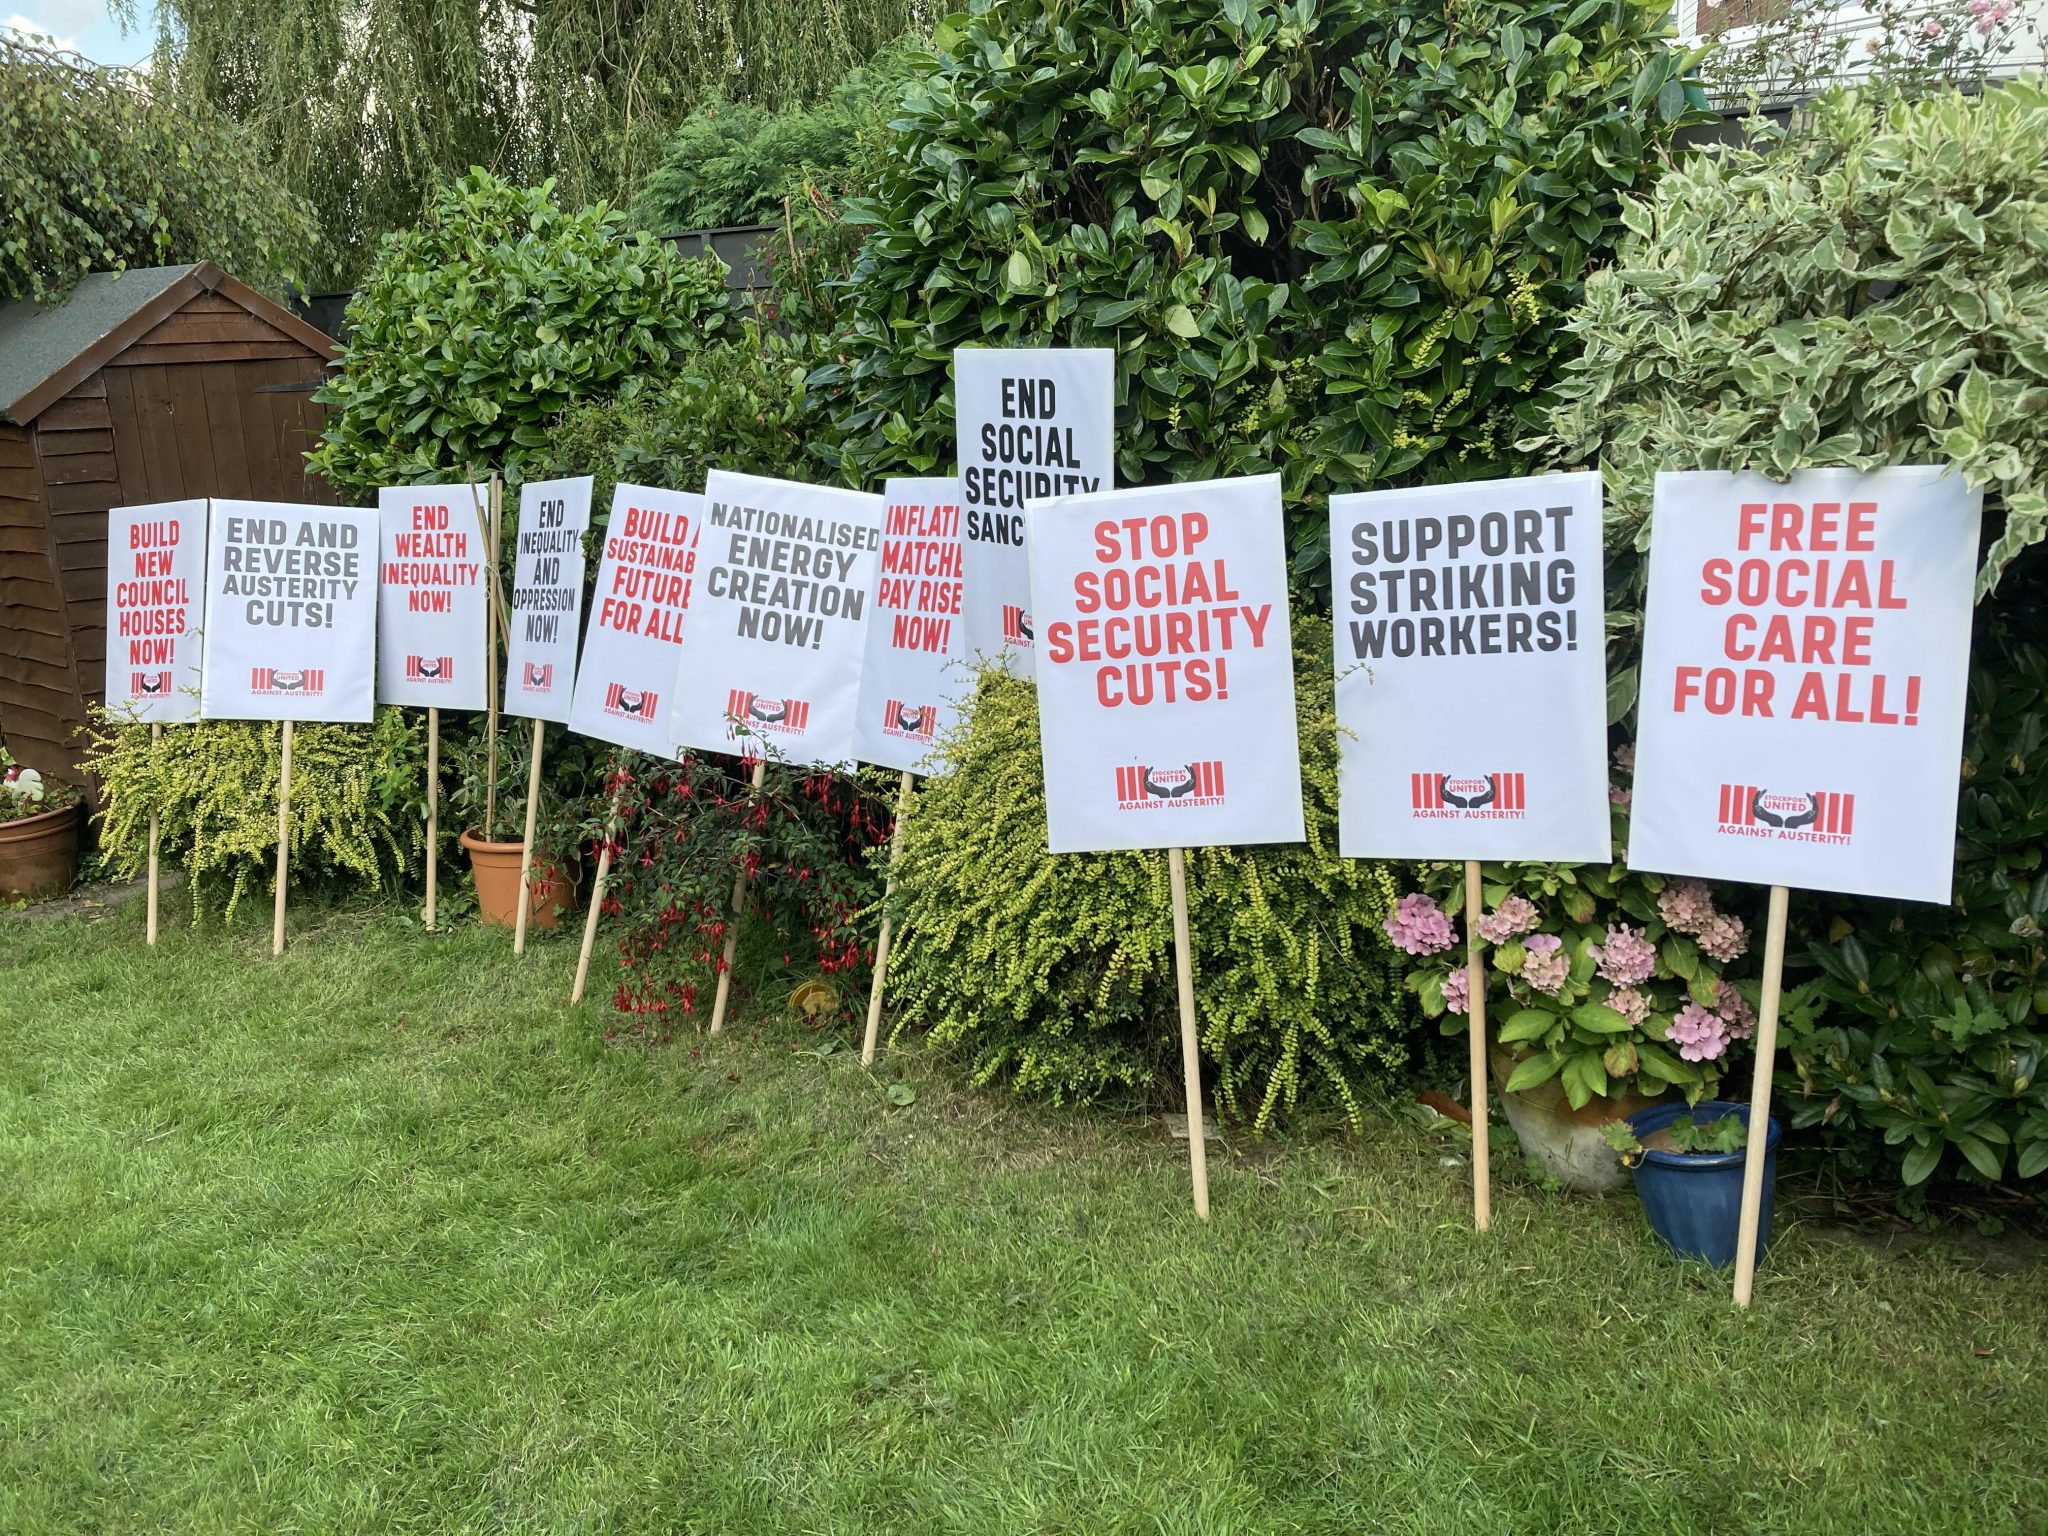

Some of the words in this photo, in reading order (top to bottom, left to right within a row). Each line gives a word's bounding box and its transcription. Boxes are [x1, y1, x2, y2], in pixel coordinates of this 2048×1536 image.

[1001, 377, 1056, 420] END
[981, 422, 1081, 470] SOCIAL
[412, 505, 449, 531] END
[538, 499, 564, 528] END
[624, 507, 689, 546] BUILD
[710, 502, 880, 552] NATIONALISED
[967, 510, 1026, 547] SANC
[1737, 502, 1878, 552] FREE
[130, 520, 180, 550] BUILD
[227, 517, 287, 546] END
[295, 521, 358, 550] AND
[395, 533, 467, 558] WEALTH
[520, 529, 579, 558] INEQUALITY
[1094, 512, 1209, 563] STOP
[1351, 506, 1573, 566] SUPPORT
[135, 551, 174, 578] NEW
[223, 546, 359, 578] REVERSE
[533, 557, 560, 586] AND
[727, 533, 857, 583] ENERGY
[222, 574, 358, 600] AUSTERITY
[382, 563, 479, 588] INEQUALITY
[1074, 559, 1239, 613] SOCIAL
[1350, 558, 1576, 615] STRIKING
[1700, 558, 1908, 610] SOCIAL
[116, 578, 189, 608] COUNCIL
[409, 590, 452, 613] NOW!
[513, 588, 576, 612] OPPRESSION
[707, 566, 865, 621] CREATION
[878, 577, 915, 610] PAY
[918, 581, 964, 615] RISE
[119, 608, 185, 637] HOUSES
[245, 600, 333, 628] CUTS!
[525, 615, 558, 643] NOW!
[600, 598, 643, 634] FOR
[644, 607, 683, 645] ALL
[737, 606, 824, 650] NOW!
[892, 614, 951, 655] NOW!
[1004, 637, 1031, 648] AGAINST
[1047, 604, 1272, 664] SECURITY
[1349, 609, 1577, 659] WORKERS!
[1723, 613, 1875, 666] CARE
[129, 638, 175, 665] NOW!
[1097, 658, 1228, 708] CUTS!
[1672, 665, 1775, 718] FOR
[1791, 671, 1922, 726] ALL!
[755, 703, 781, 712] UNITED
[762, 722, 805, 736] AUSTERITY!
[1152, 769, 1186, 777] STOCKPORT
[1152, 774, 1187, 784] UNITED
[1449, 784, 1486, 793] UNITED
[1764, 794, 1807, 803] STOCKPORT
[1119, 800, 1164, 811] AGAINST
[1167, 797, 1225, 808] AUSTERITY!
[1413, 810, 1460, 819] AGAINST
[1464, 810, 1525, 819] AUSTERITY!
[1763, 800, 1807, 812] UNITED
[1718, 824, 1774, 838] AGAINST
[1778, 830, 1851, 846] AUSTERITY!
